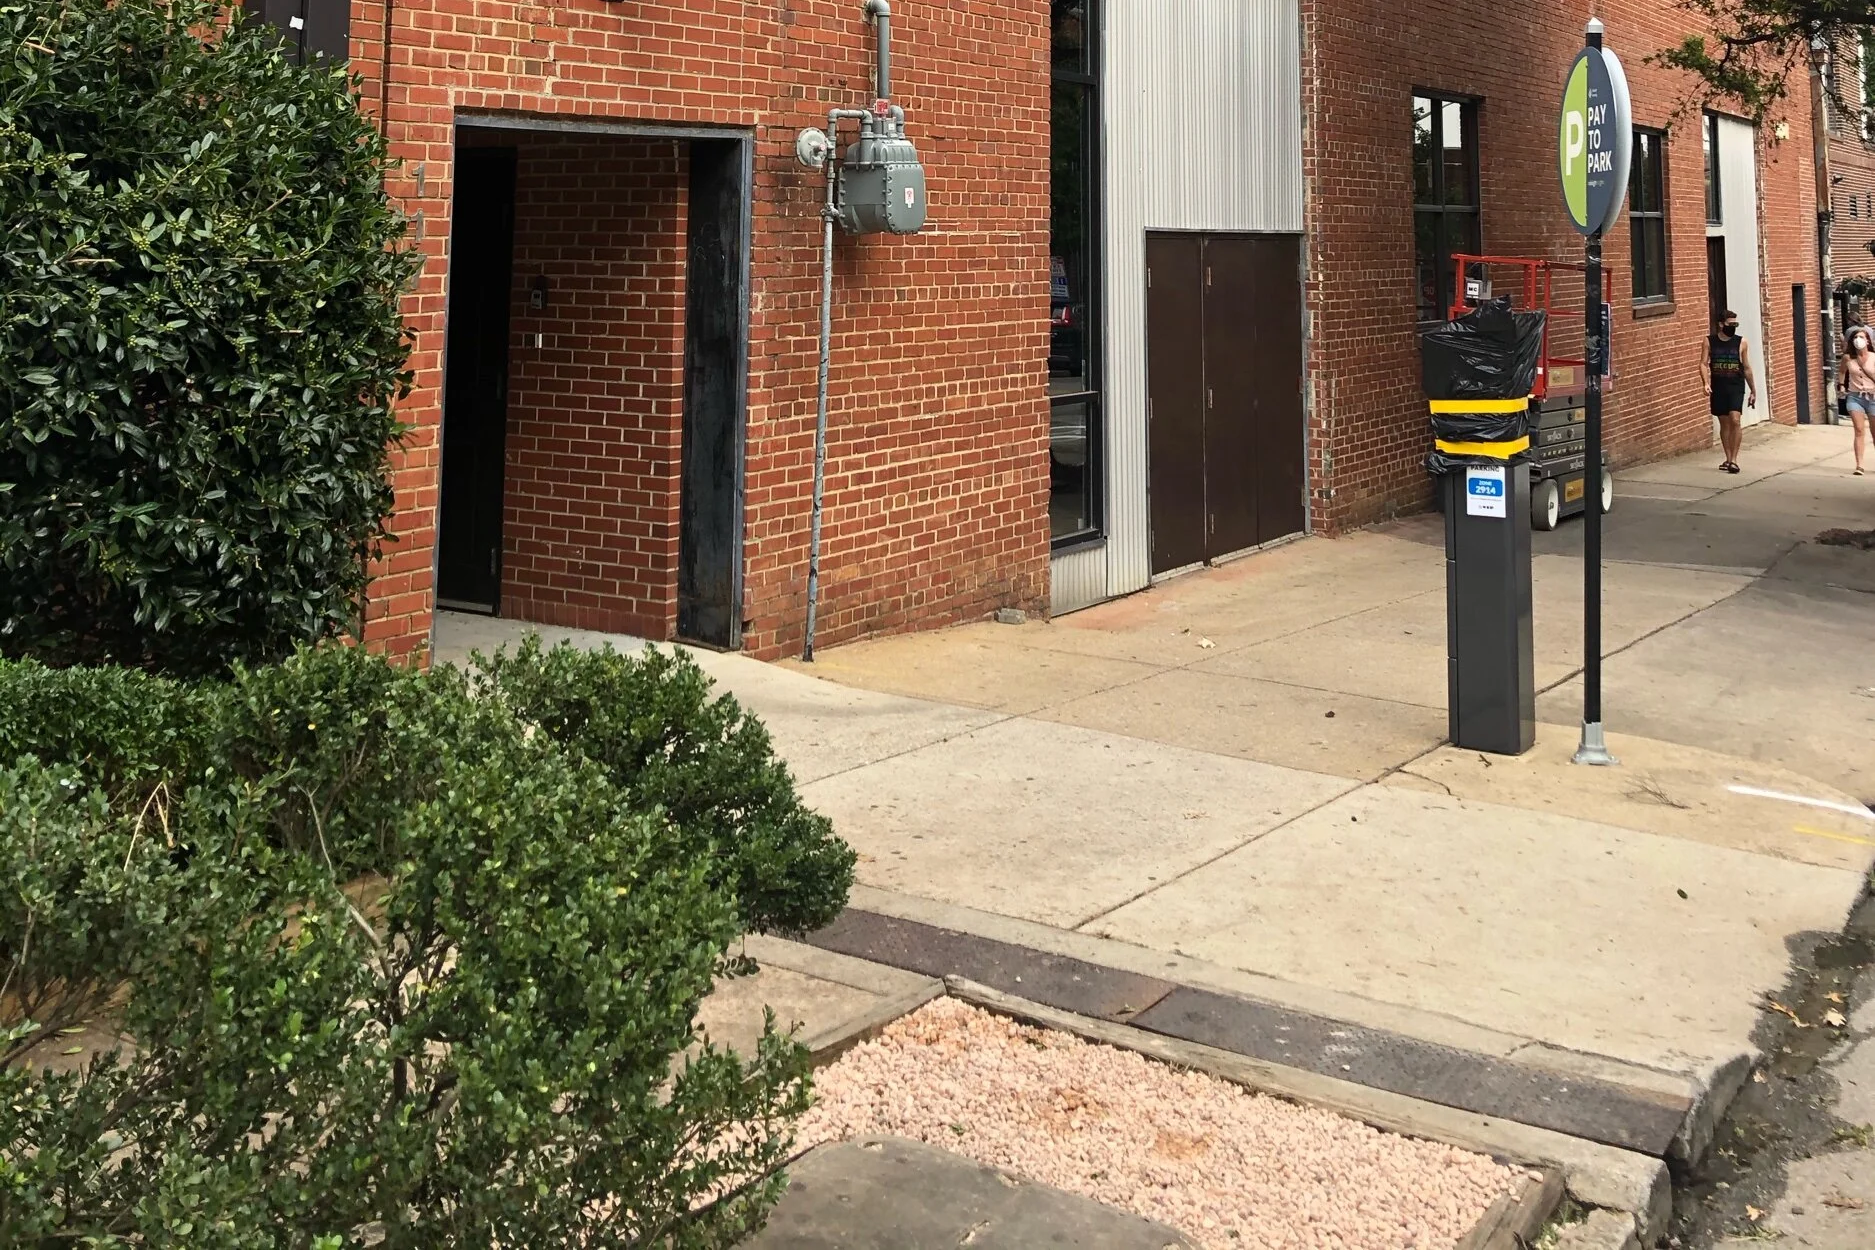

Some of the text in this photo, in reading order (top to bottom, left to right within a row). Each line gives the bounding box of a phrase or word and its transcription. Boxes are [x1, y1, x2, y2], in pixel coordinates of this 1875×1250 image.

[1587, 103, 1607, 127] PAY
[1565, 110, 1584, 176] P
[1588, 128, 1601, 150] TO
[1587, 150, 1612, 174] PARK
[1475, 485, 1496, 494] 2914
